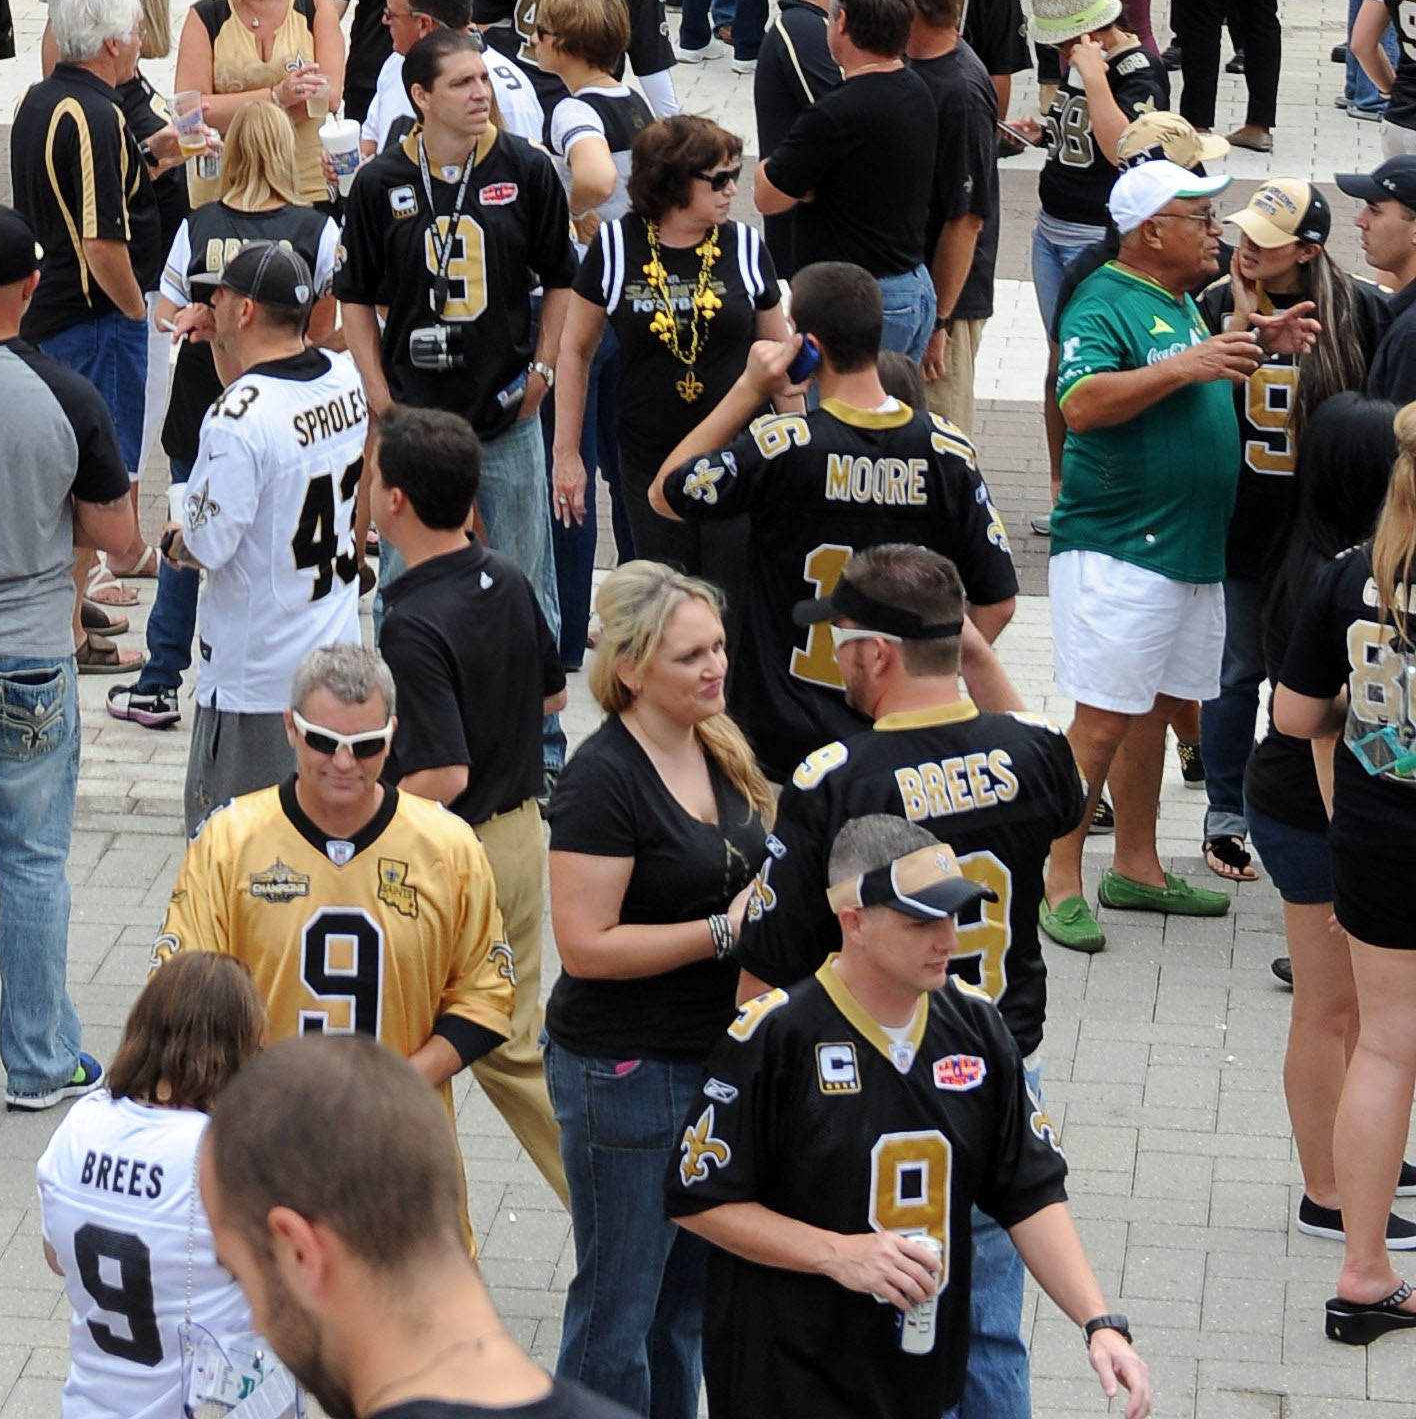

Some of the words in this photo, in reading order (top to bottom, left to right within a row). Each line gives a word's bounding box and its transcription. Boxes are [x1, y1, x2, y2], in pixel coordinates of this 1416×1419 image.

[494, 65, 520, 91] 9
[424, 214, 489, 322] 9
[826, 453, 929, 506] MOORE
[792, 741, 849, 791] 9
[893, 749, 1020, 821] BREES
[252, 883, 307, 894] CHAMPIONS
[299, 906, 384, 1043] 9
[81, 1148, 167, 1200] BREES
[867, 1129, 953, 1299] 9
[73, 1221, 165, 1368] 9
